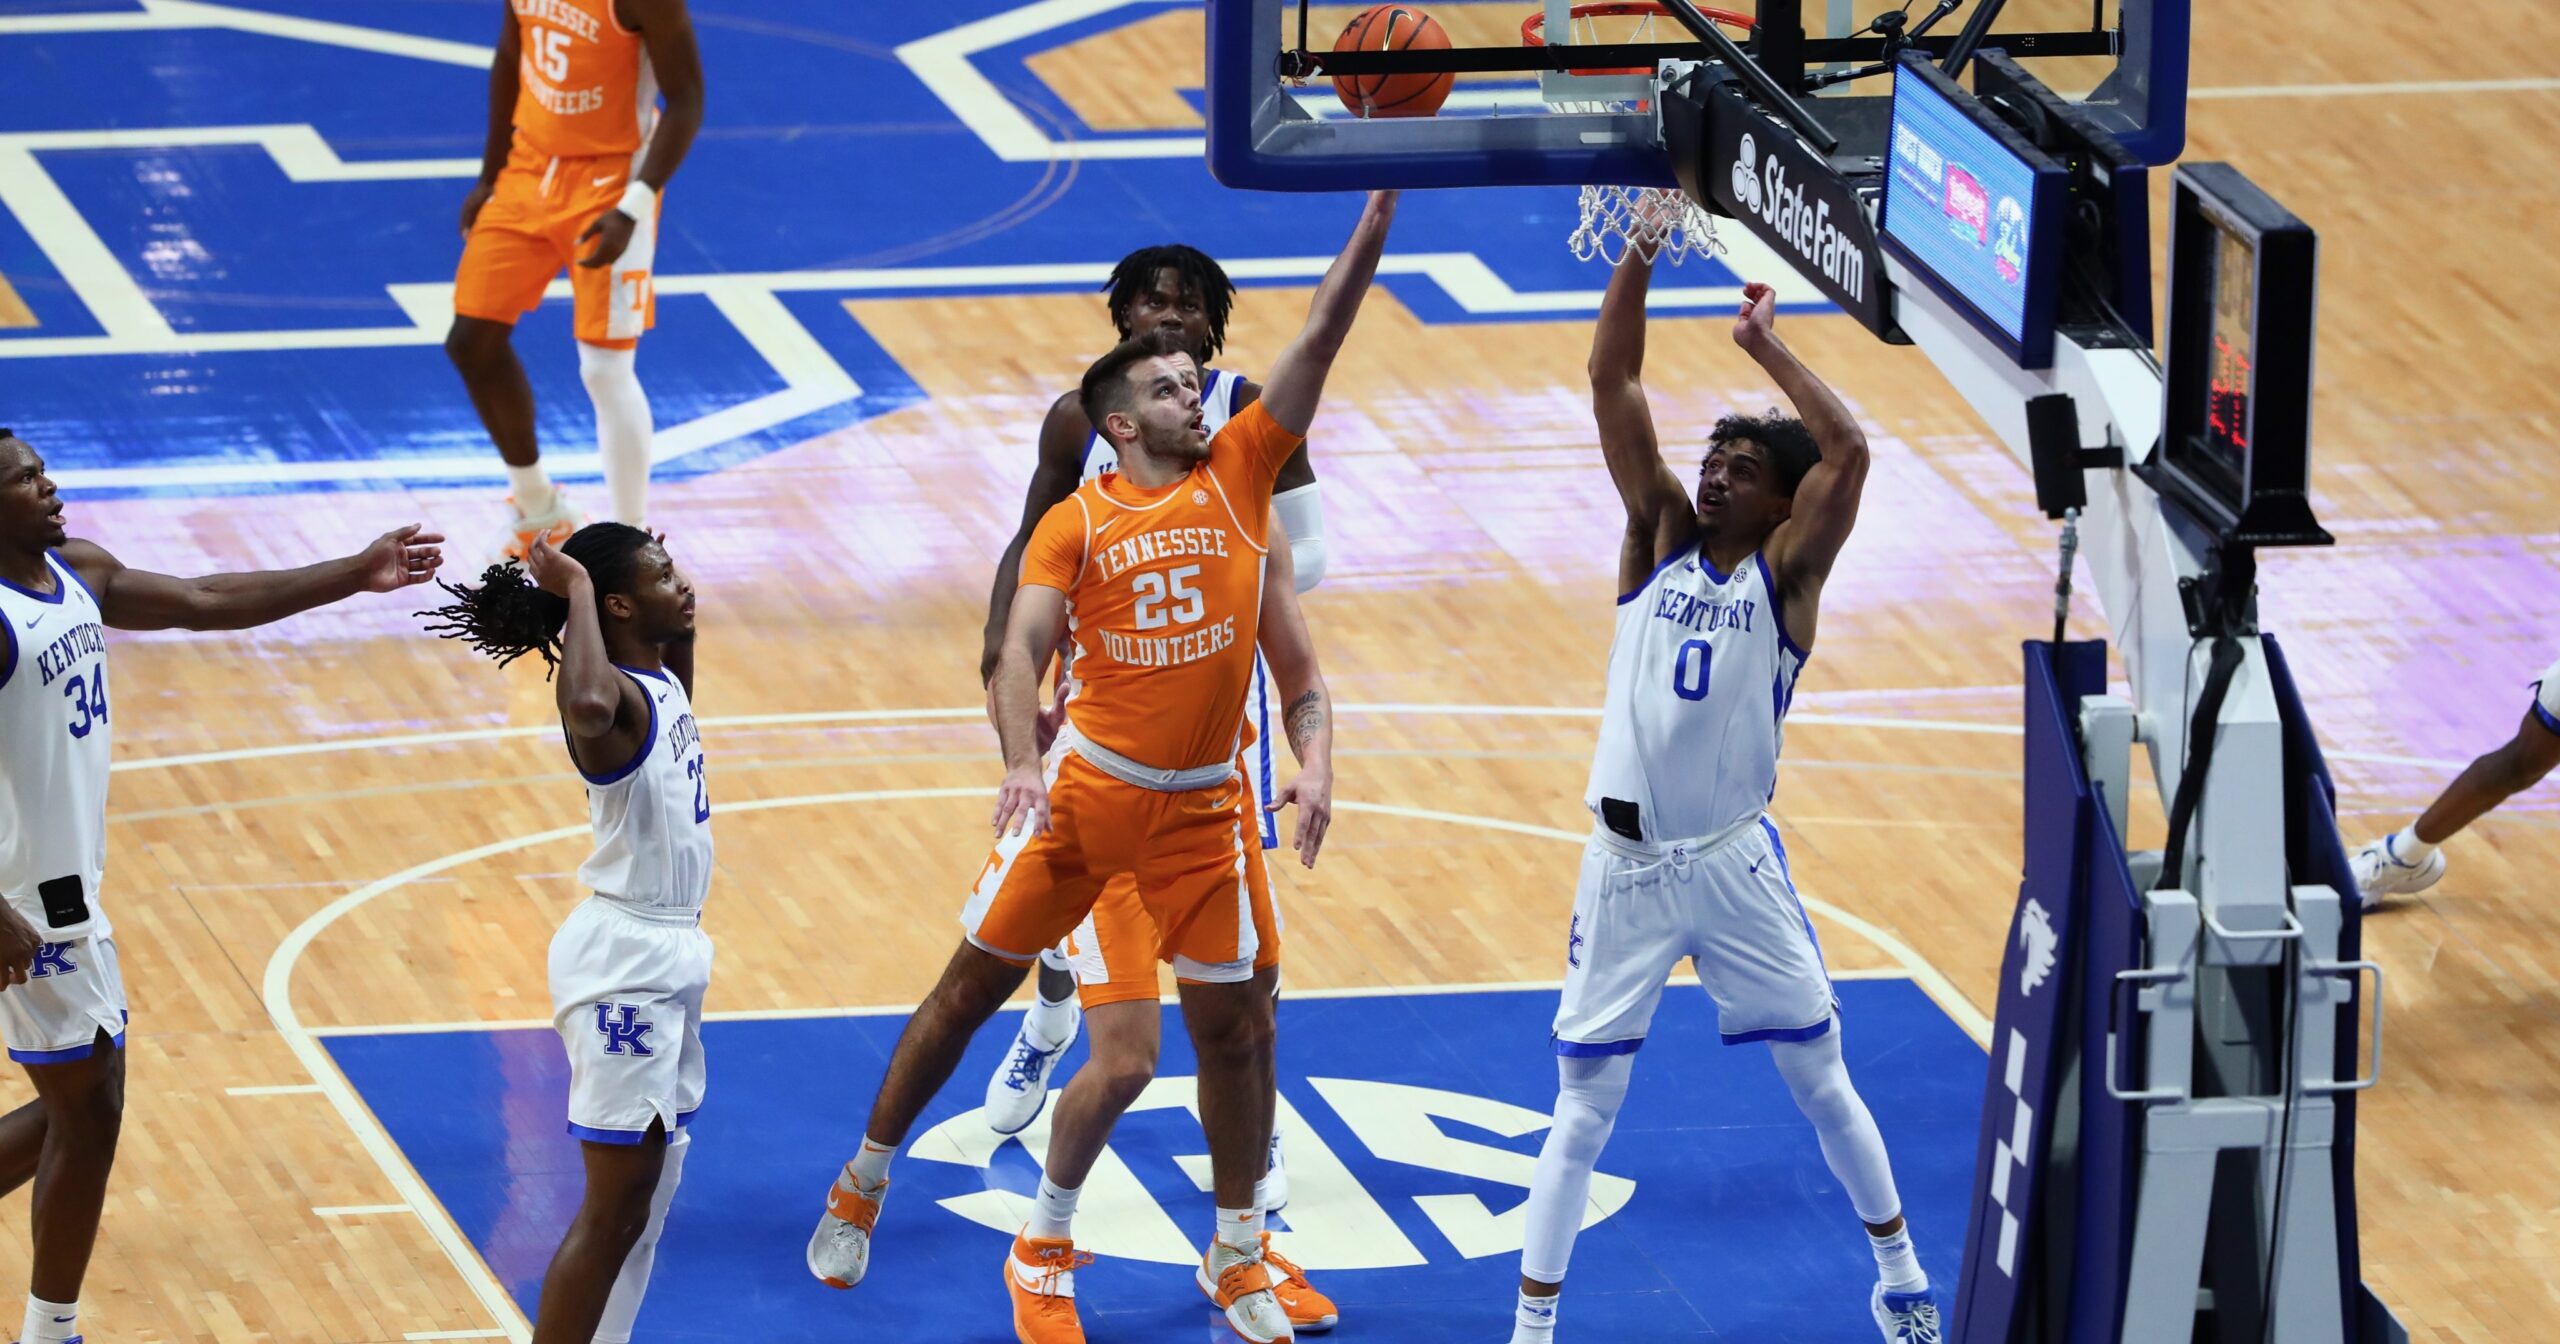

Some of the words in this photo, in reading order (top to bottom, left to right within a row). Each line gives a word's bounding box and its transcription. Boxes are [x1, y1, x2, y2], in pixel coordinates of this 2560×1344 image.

[531, 26, 572, 83] 15
[1094, 527, 1229, 582] TENNESSEE
[1131, 563, 1206, 631] 25
[1098, 613, 1236, 667] VOLUNTEERS
[1673, 638, 1713, 702] 0
[63, 662, 108, 739] 34
[594, 1000, 654, 1057] UK
